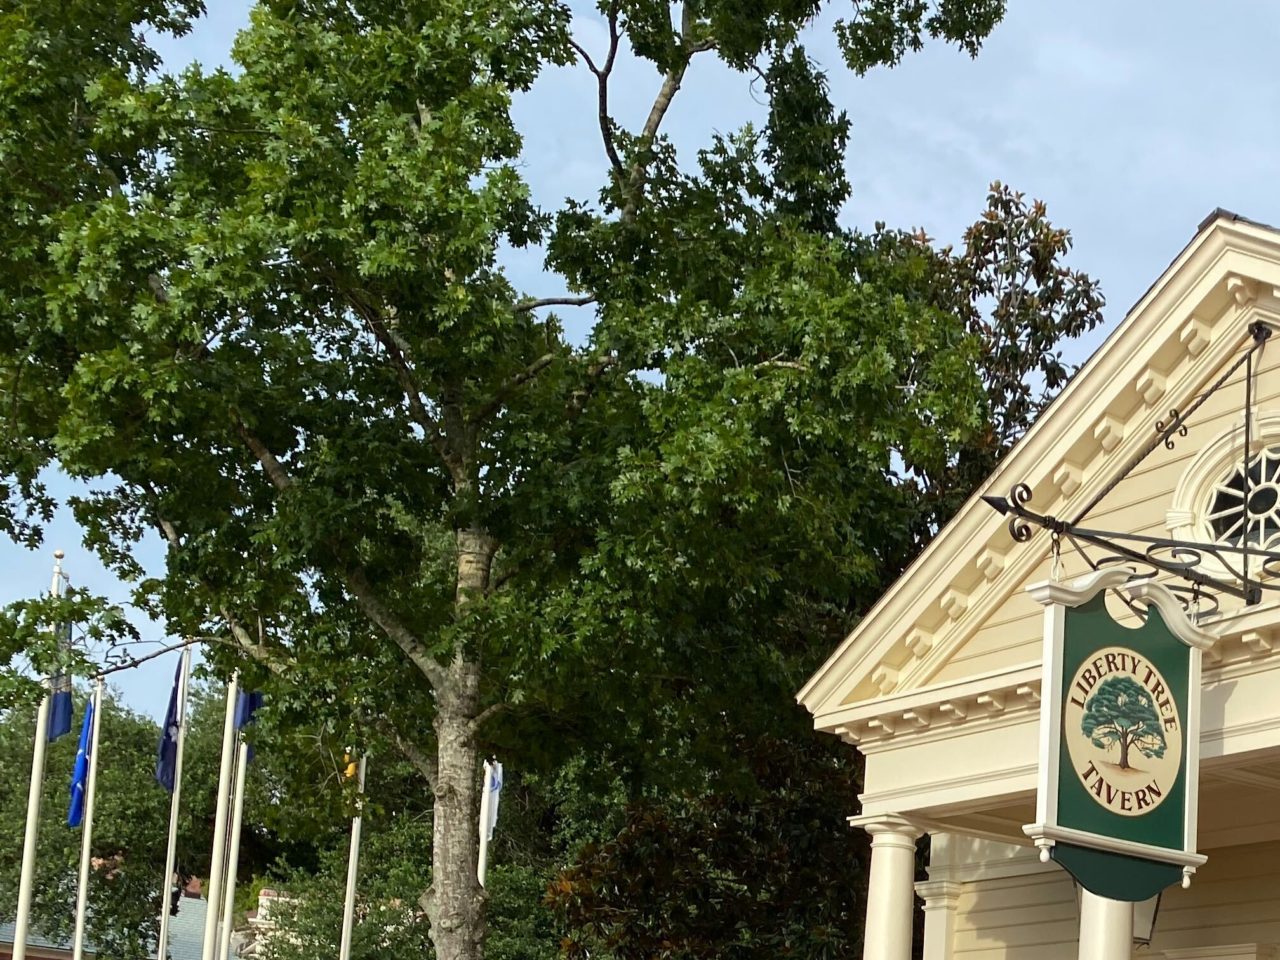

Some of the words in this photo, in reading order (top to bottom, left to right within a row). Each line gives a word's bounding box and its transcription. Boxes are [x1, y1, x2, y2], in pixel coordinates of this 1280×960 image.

[1070, 653, 1141, 711] LIBERTY
[1142, 665, 1178, 733] TREE
[1081, 760, 1163, 812] TAVERN
